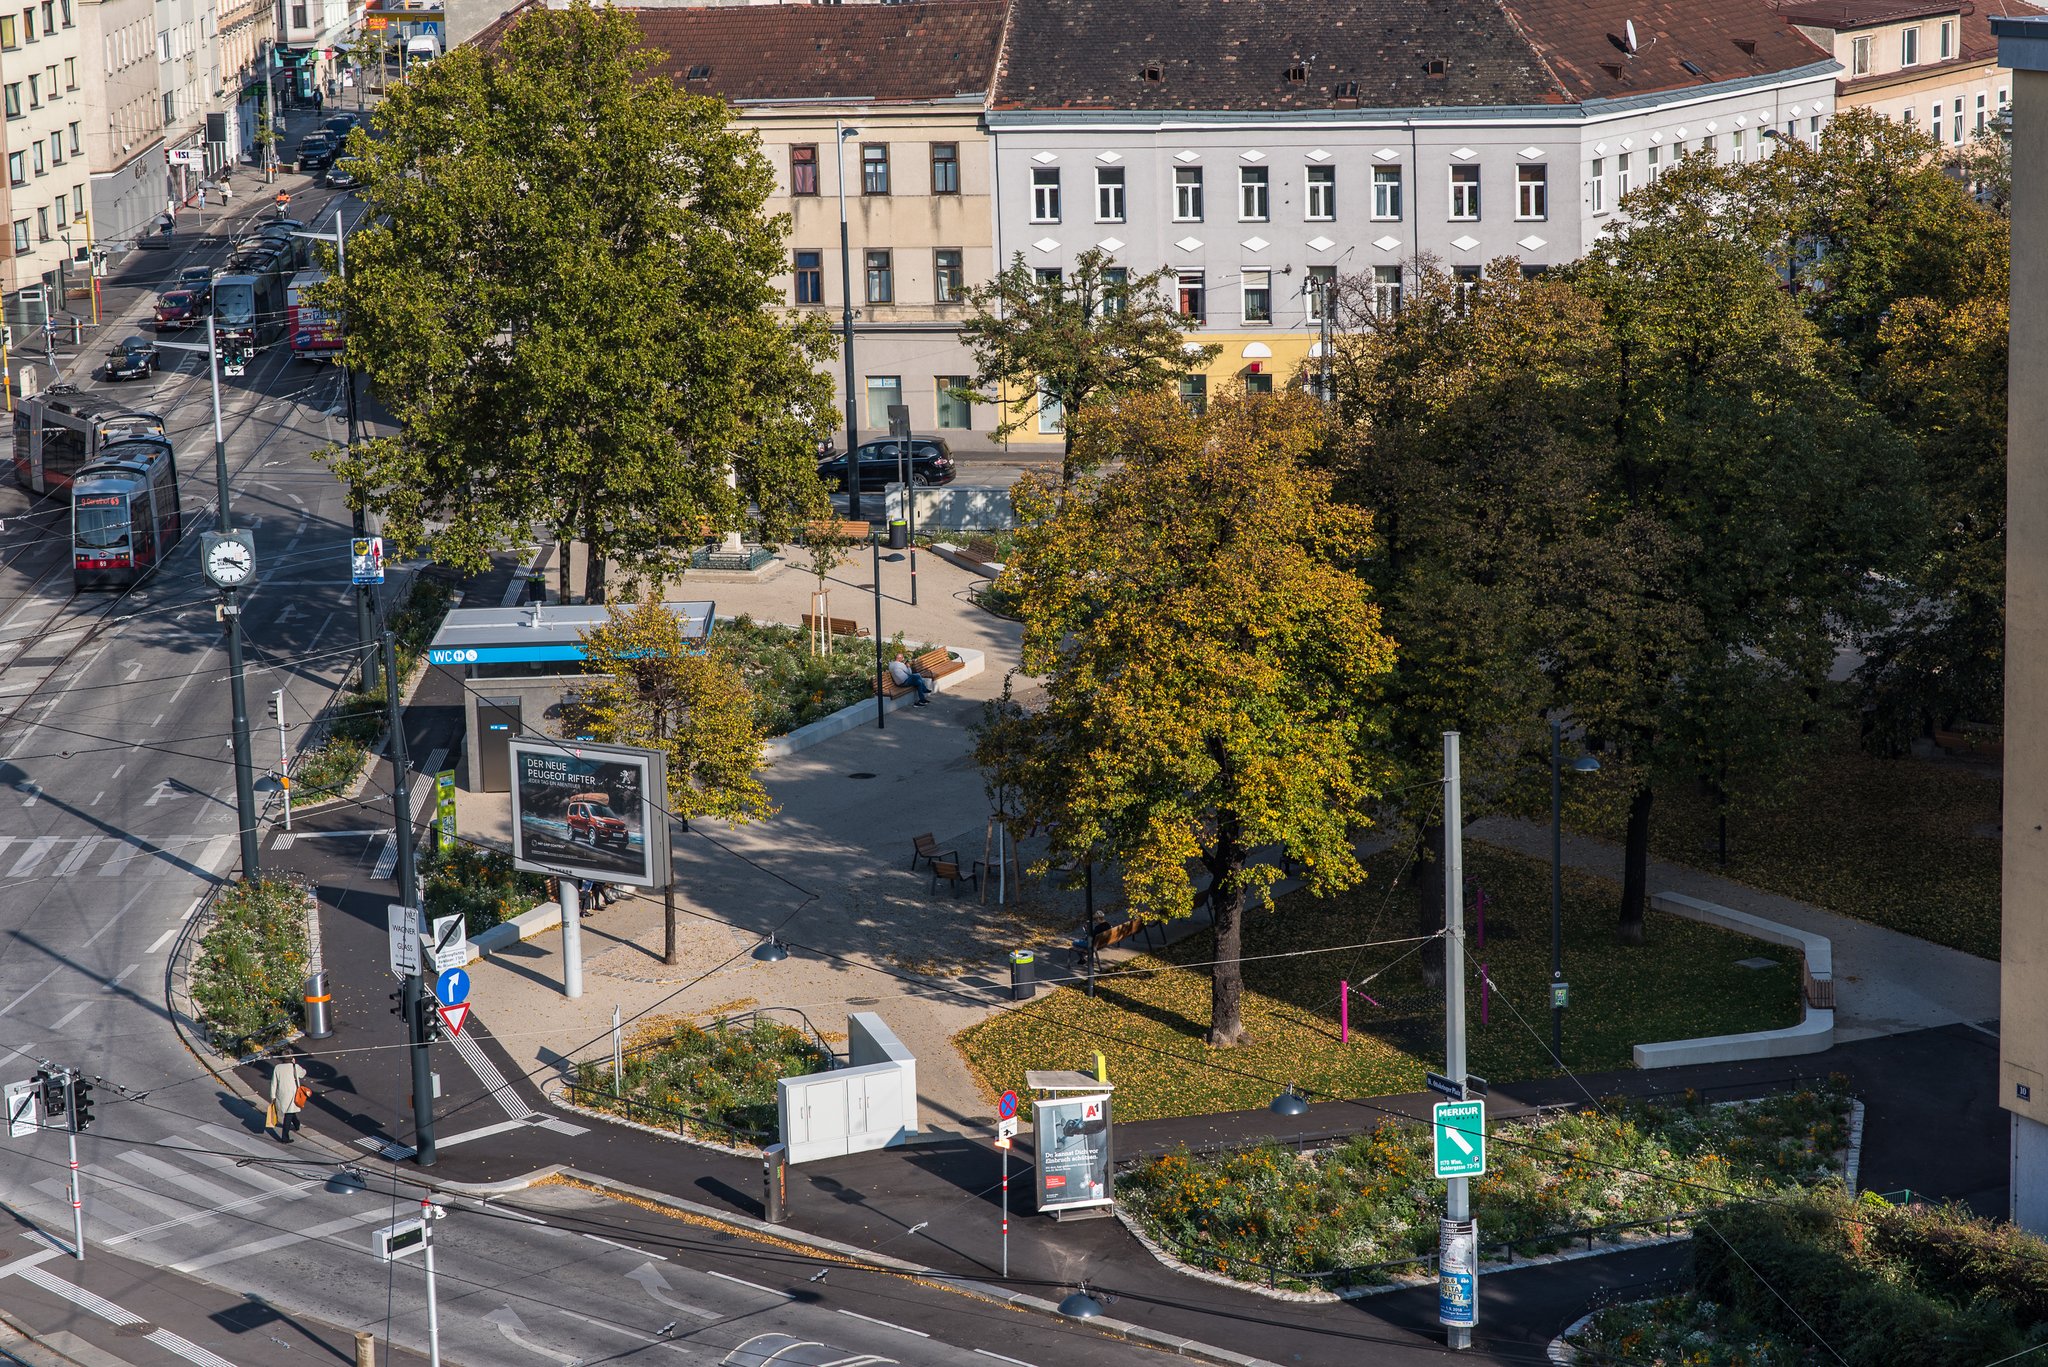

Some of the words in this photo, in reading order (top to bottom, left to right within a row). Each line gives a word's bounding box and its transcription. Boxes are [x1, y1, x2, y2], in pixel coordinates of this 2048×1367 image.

[434, 651, 452, 662] WC
[527, 759, 544, 769] DER
[546, 761, 567, 772] NEUE
[528, 769, 566, 781] PEUGEOT
[568, 774, 596, 785] RIFTER
[392, 924, 416, 935] WAGNER
[397, 942, 413, 952] GLASS
[2020, 1086, 2026, 1095] 10
[1086, 1103, 1099, 1118] A1
[1438, 1106, 1478, 1117] MERKUR
